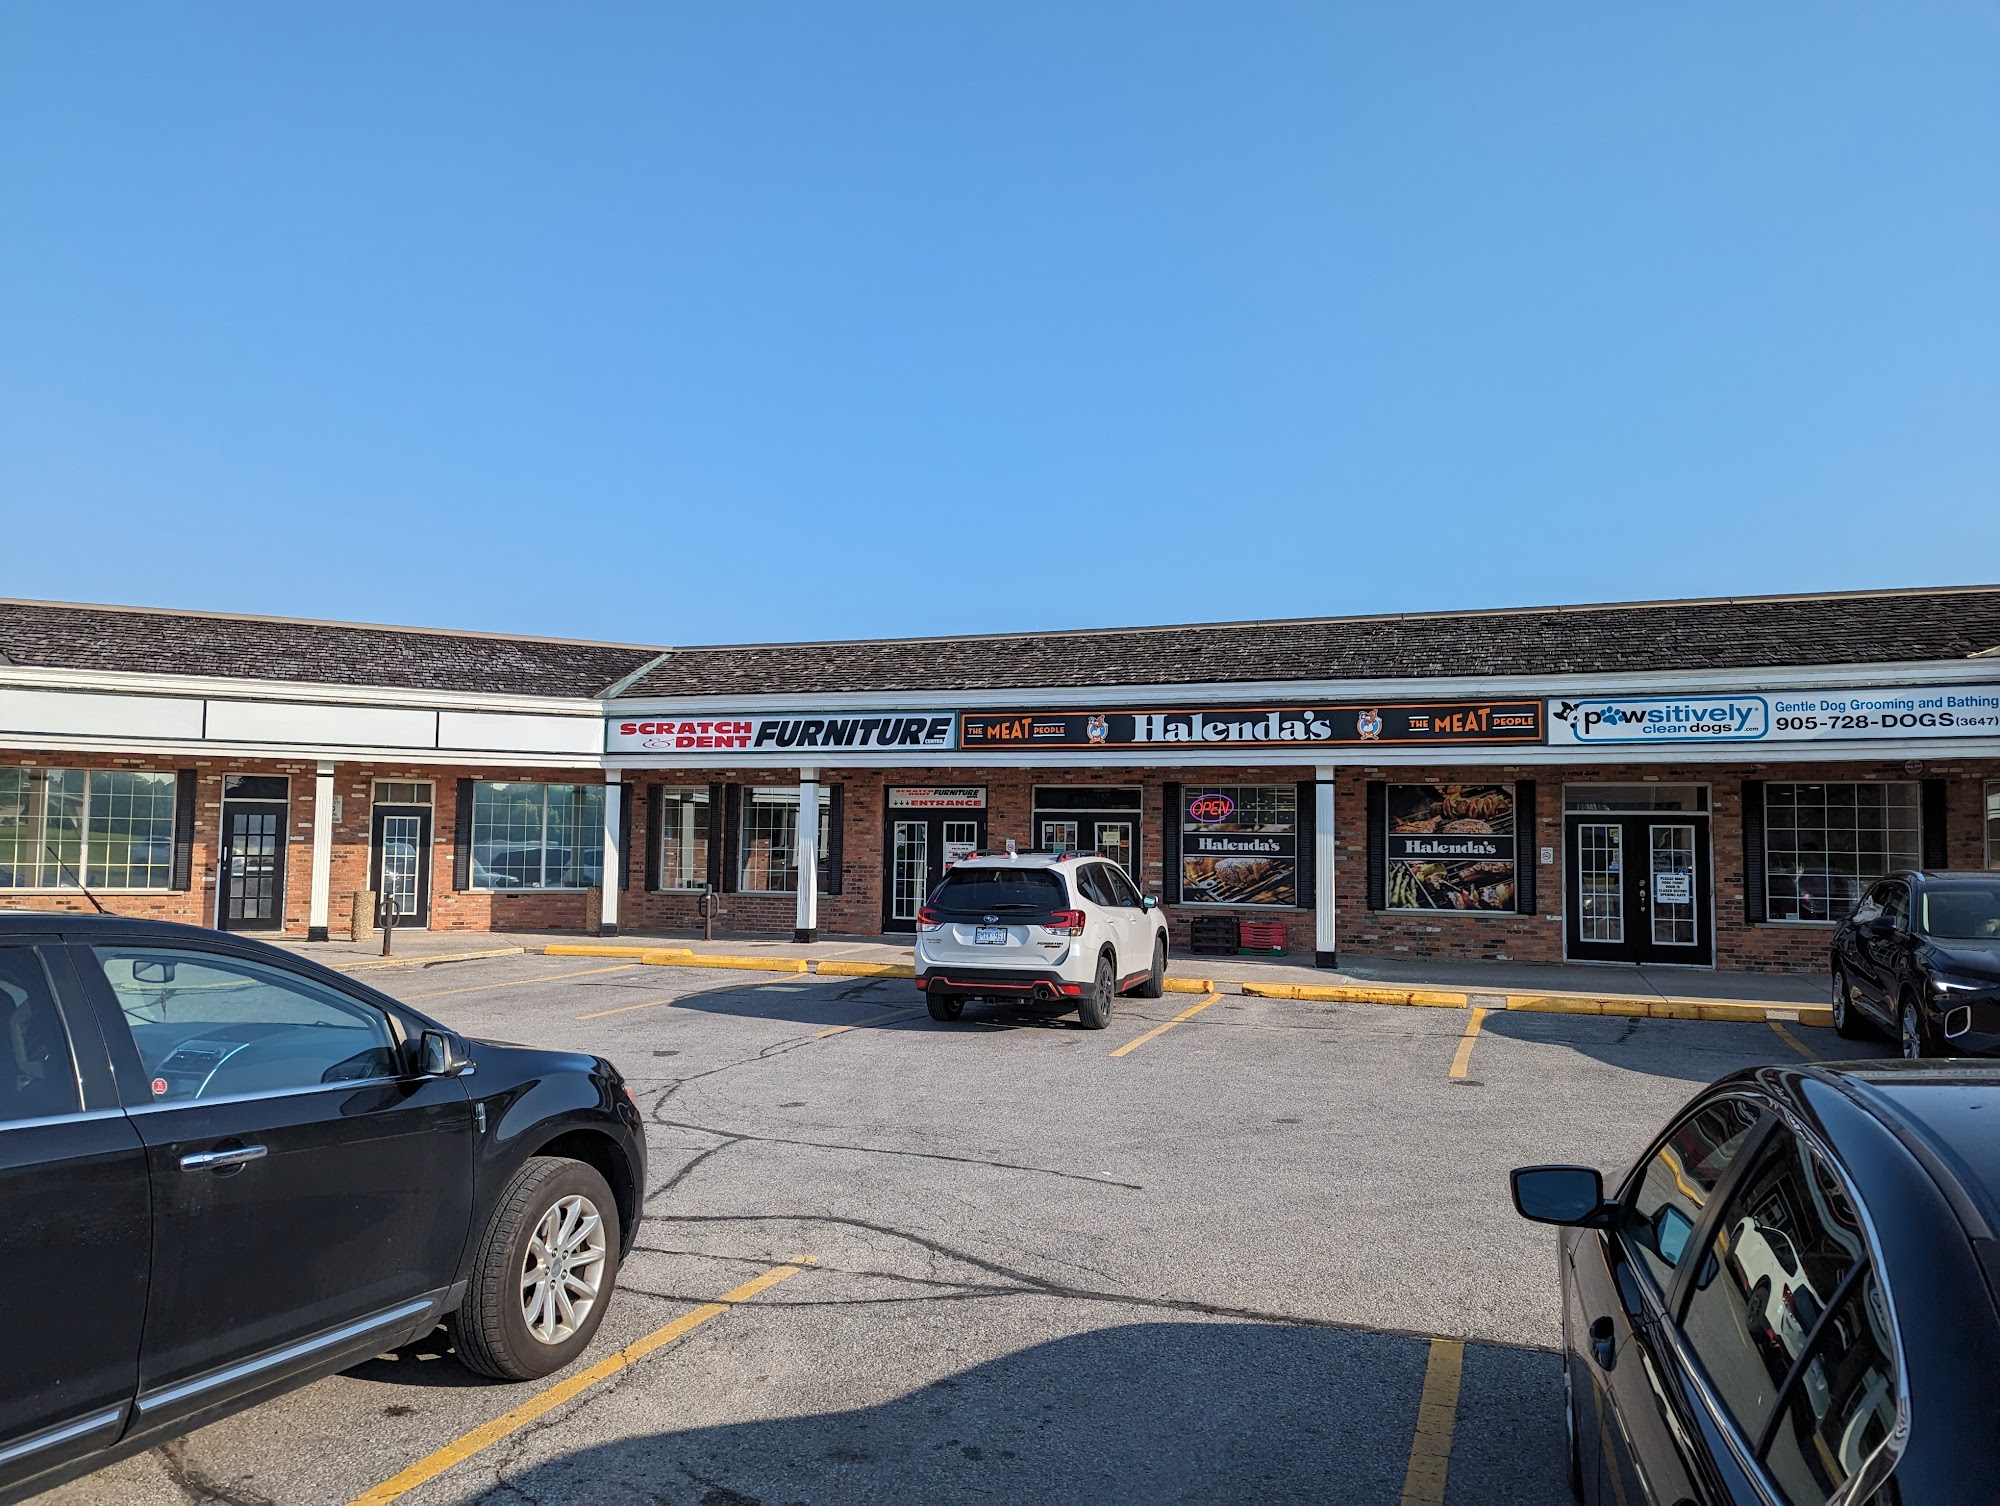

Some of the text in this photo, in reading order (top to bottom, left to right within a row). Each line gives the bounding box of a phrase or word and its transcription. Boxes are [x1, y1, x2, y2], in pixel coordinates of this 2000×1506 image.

[1775, 695, 2000, 713] Gentle Dog Grooming and Bathing
[1131, 711, 1332, 742] Halenda's
[1409, 708, 1534, 732] THE MEAT PEOPLE
[620, 721, 753, 735] SCRATCH
[753, 717, 953, 747] FURNITURE
[967, 717, 1066, 740] THE MEAT PEOPLE
[1642, 724, 1687, 734] clean
[1689, 722, 1732, 735] dogs
[675, 736, 752, 748] DENT
[1192, 801, 1230, 815] OPEN
[1198, 837, 1280, 852] Halenda's
[1405, 840, 1496, 855] Halenda's
